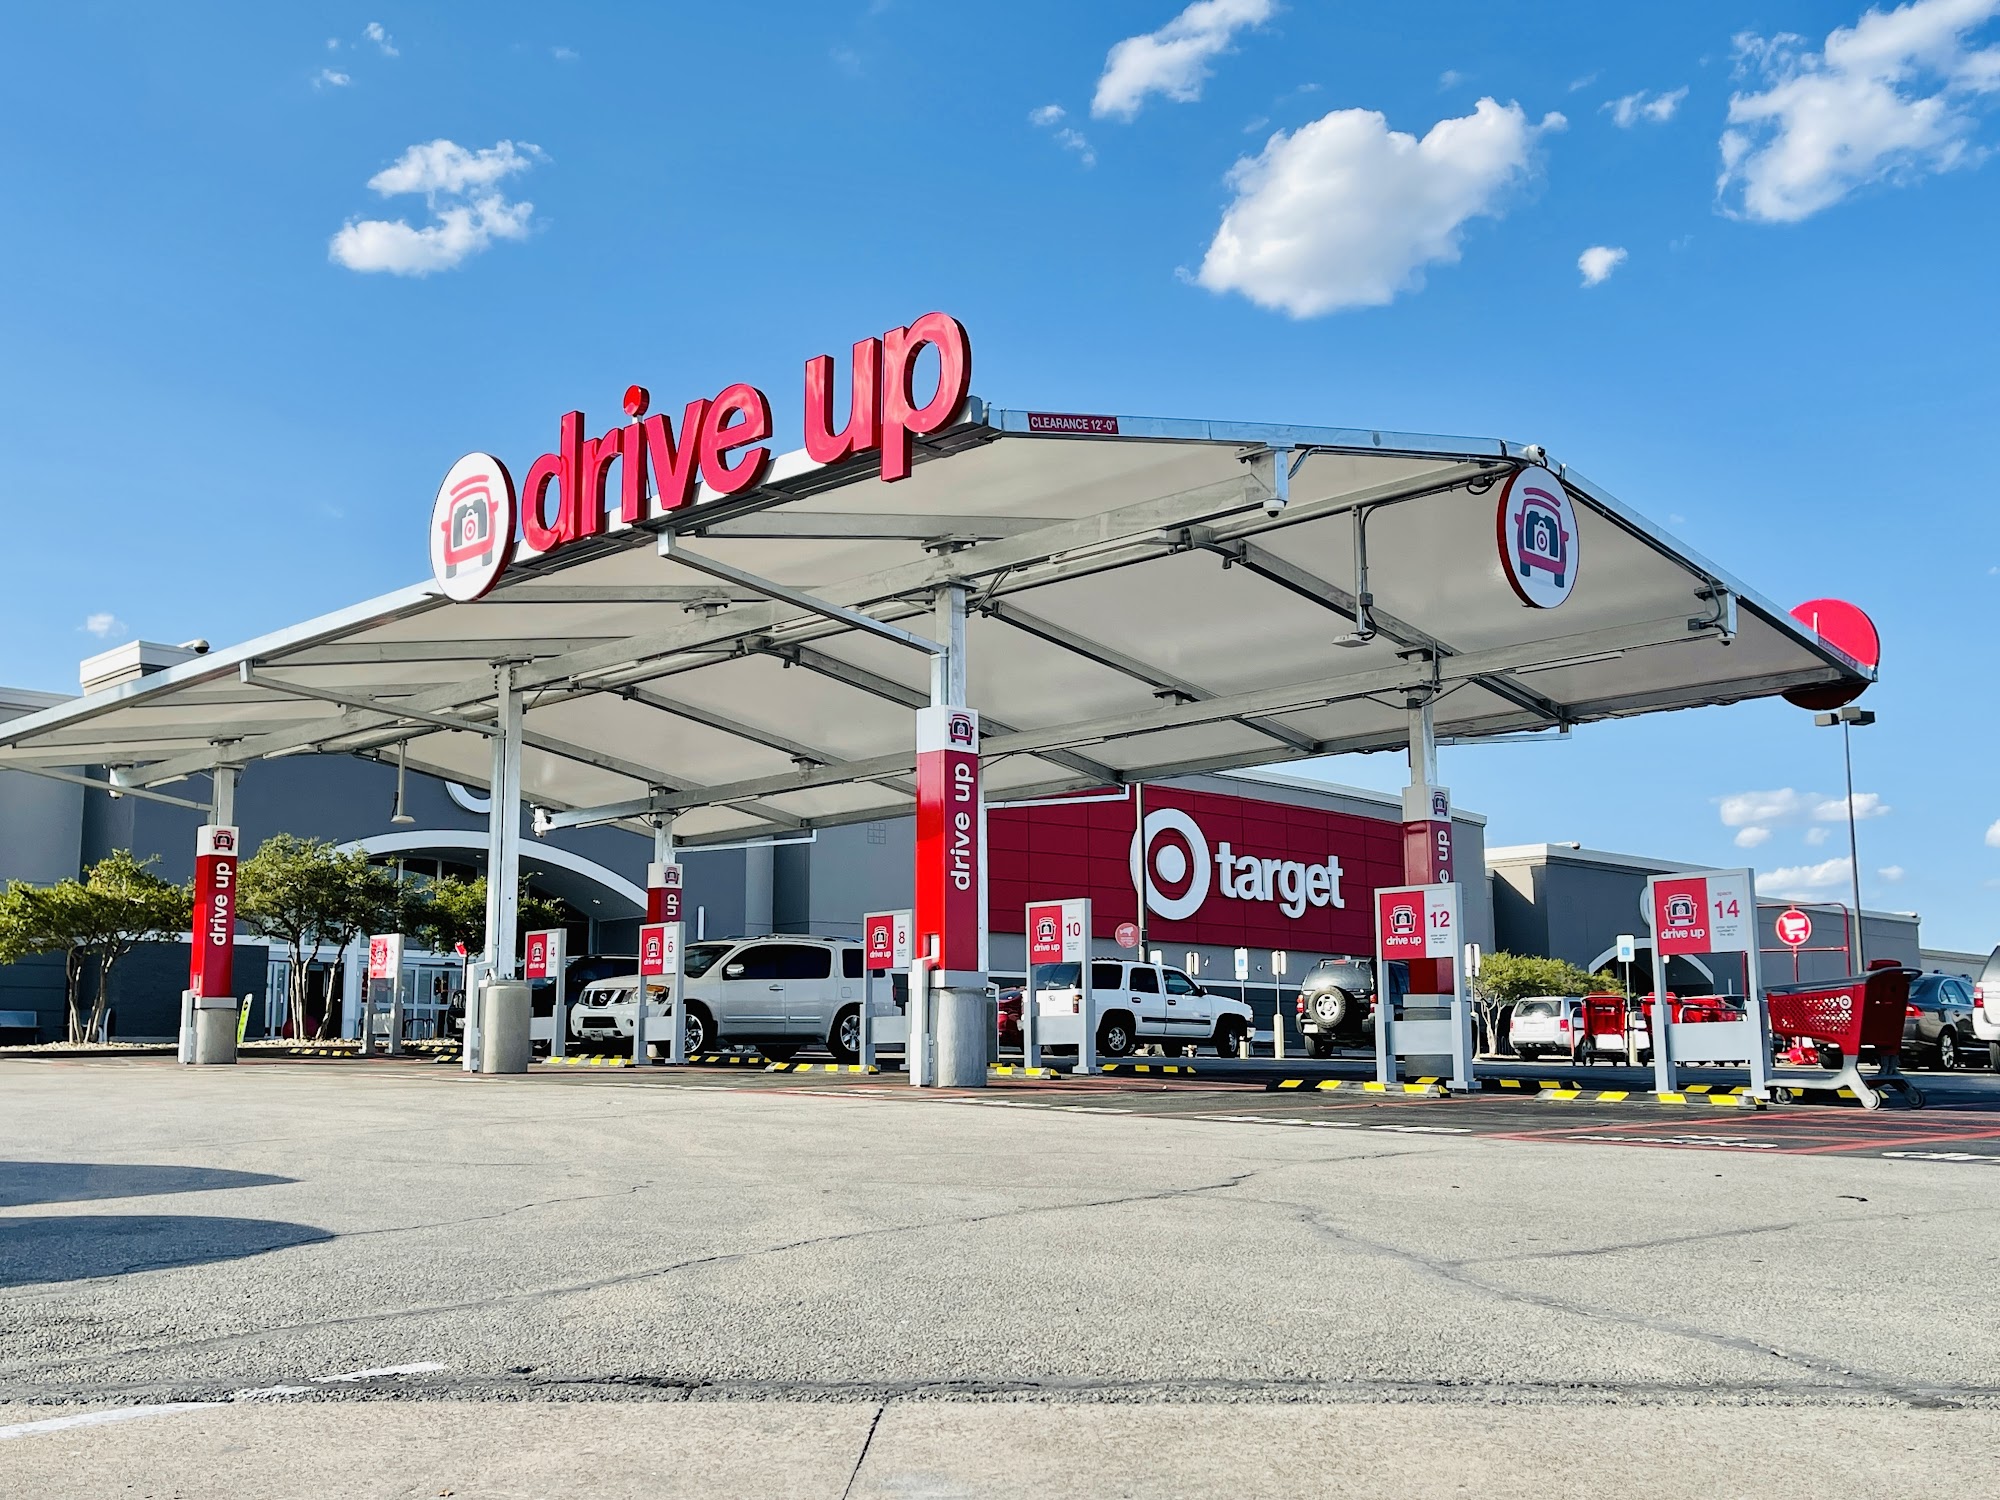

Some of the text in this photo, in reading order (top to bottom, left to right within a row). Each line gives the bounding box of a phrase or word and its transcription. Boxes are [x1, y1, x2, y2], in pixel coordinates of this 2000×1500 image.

[1030, 416, 1089, 430] CLEARANCE
[521, 311, 972, 552] drive up
[949, 763, 975, 890] drive up
[1437, 830, 1450, 861] up
[1215, 842, 1345, 918] target
[209, 862, 233, 946] drive up
[666, 893, 680, 916] up
[1714, 899, 1740, 918] 14
[1429, 910, 1451, 928] 12
[898, 931, 905, 944] 8
[1066, 922, 1081, 937] 10
[1661, 928, 1705, 940] drive up
[667, 941, 674, 953] 6
[1033, 943, 1050, 952] drive
[1050, 944, 1060, 952] up
[1386, 935, 1408, 946] drive
[1410, 936, 1422, 946] up
[550, 946, 556, 957] 4
